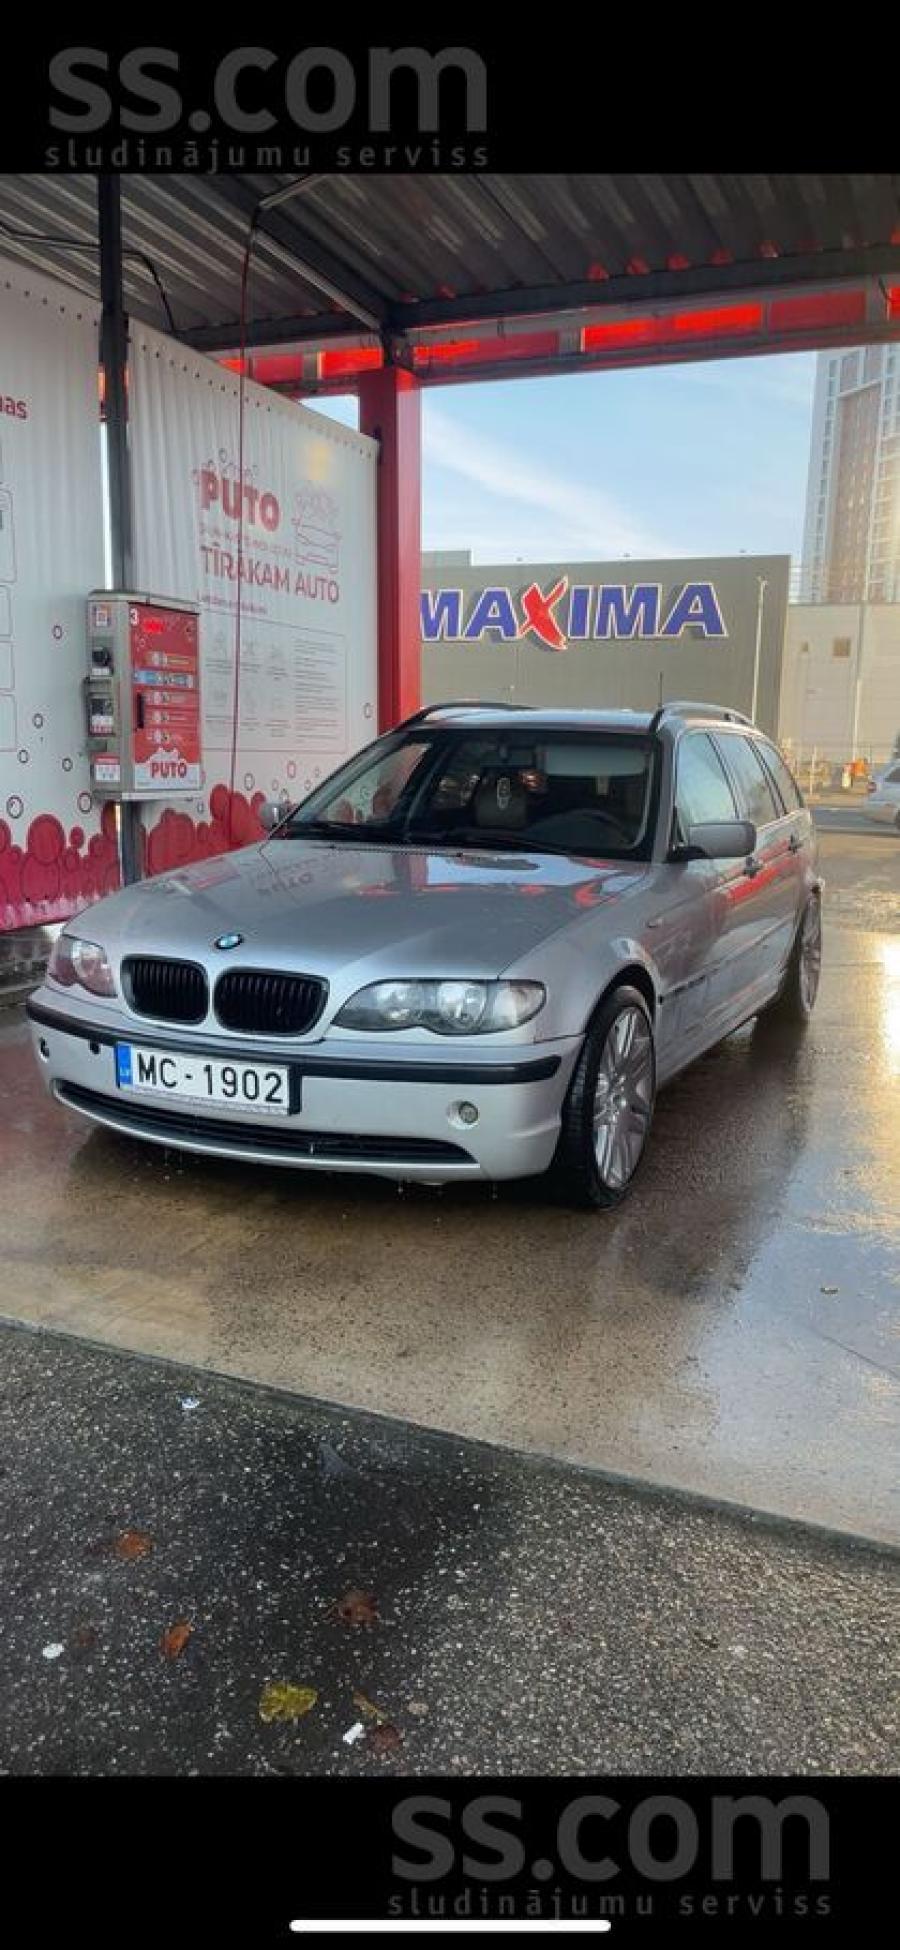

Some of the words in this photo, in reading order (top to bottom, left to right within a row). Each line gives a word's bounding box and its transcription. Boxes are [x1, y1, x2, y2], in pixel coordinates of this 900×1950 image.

[0, 396, 27, 419] as
[199, 470, 279, 531] PUTO
[295, 571, 340, 603] AUTO
[130, 608, 138, 625] 3
[421, 575, 728, 650] MAXIMA
[151, 762, 187, 778] PUTO
